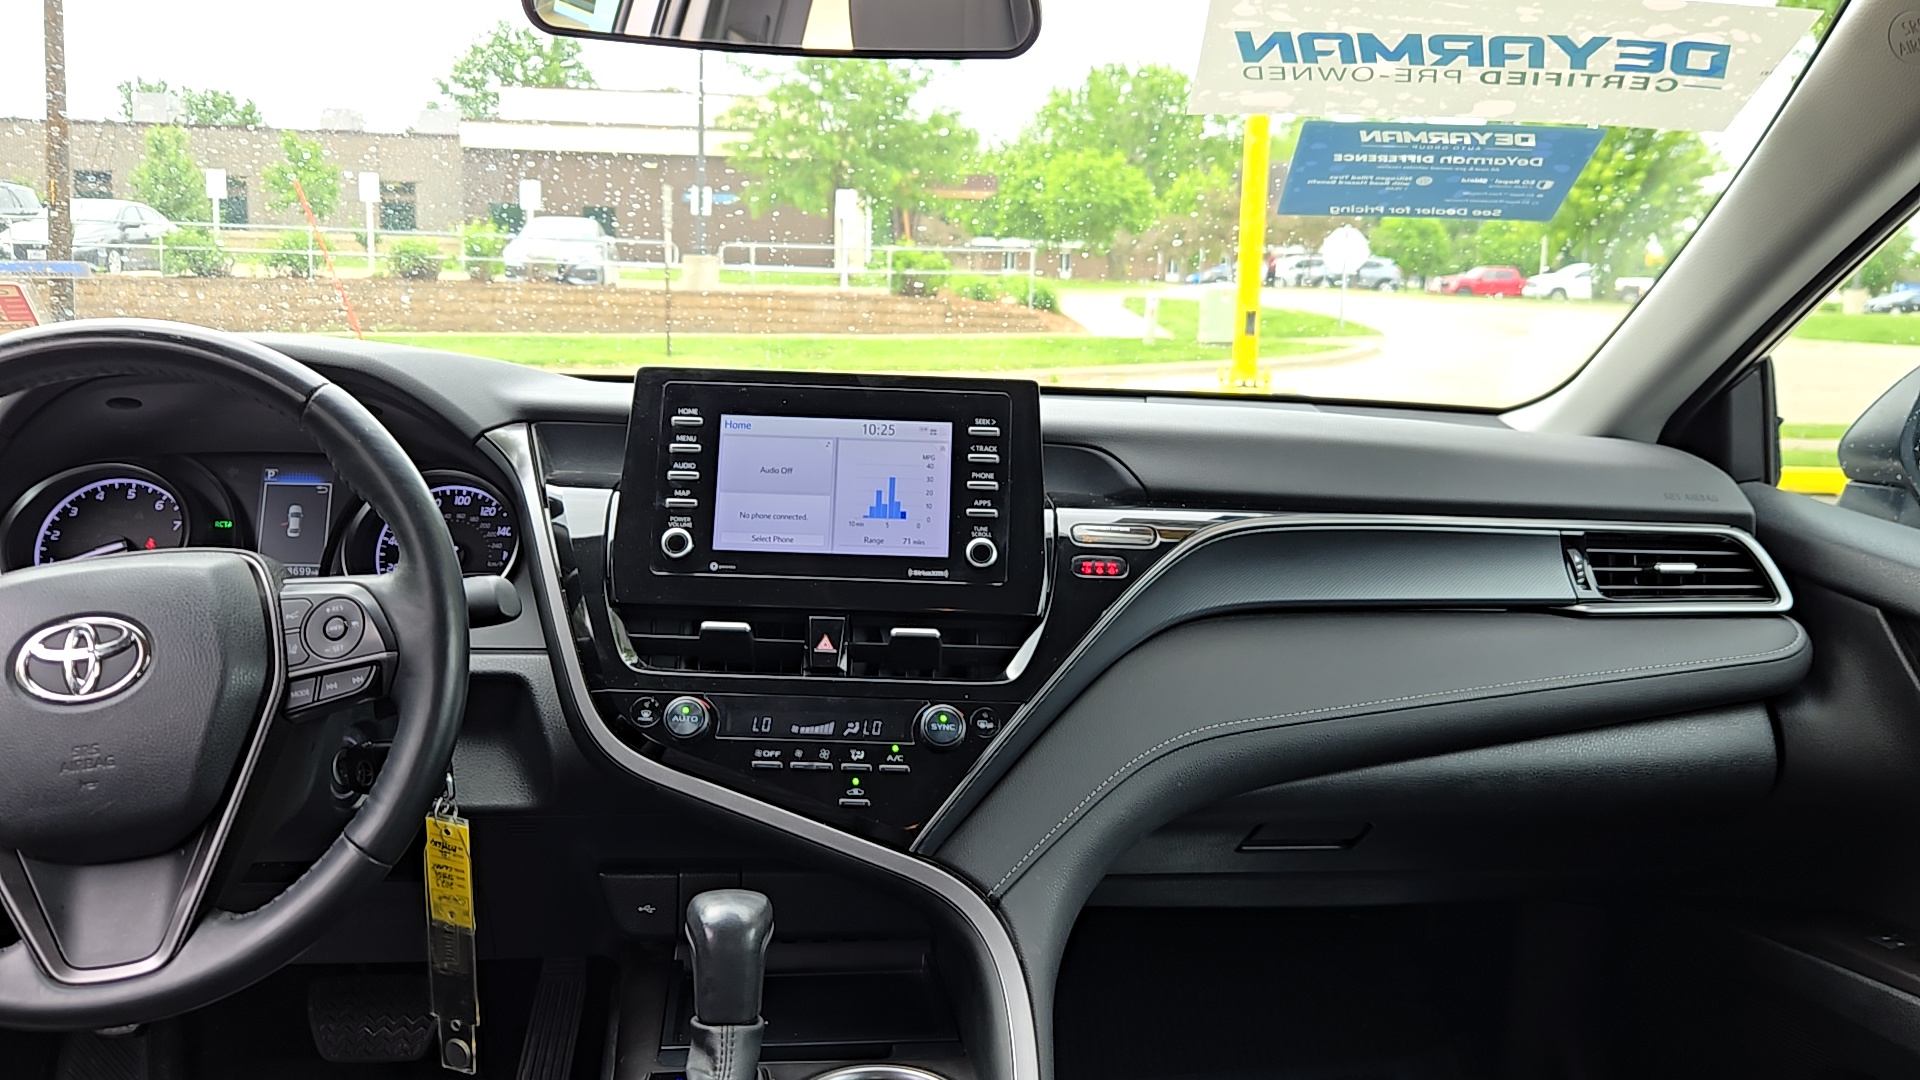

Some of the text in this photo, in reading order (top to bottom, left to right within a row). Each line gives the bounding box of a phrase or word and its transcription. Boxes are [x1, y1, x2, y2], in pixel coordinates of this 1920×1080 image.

[677, 408, 699, 416] HOME
[724, 420, 896, 437] Home 10:25
[675, 434, 698, 443] MENU
[975, 445, 998, 453] TRACK
[922, 454, 936, 462] MPG
[672, 462, 697, 470] AUDIO
[759, 466, 794, 475] Audio Off
[971, 472, 995, 480] PHONE
[95, 491, 105, 501] 4
[126, 489, 137, 500] 5
[454, 495, 472, 506] 100
[973, 499, 992, 507] APPS
[154, 500, 165, 511] 6
[68, 507, 79, 517] 3
[480, 506, 497, 517] 120
[738, 511, 808, 522] No phone connected.
[172, 520, 182, 531] 7
[50, 530, 61, 541] 2
[751, 535, 794, 544] Select Phone
[863, 537, 885, 546] Range
[671, 715, 699, 723] AUTO
[930, 723, 957, 732] SYNC
[762, 750, 781, 758] OFF
[886, 754, 904, 763] A/C
